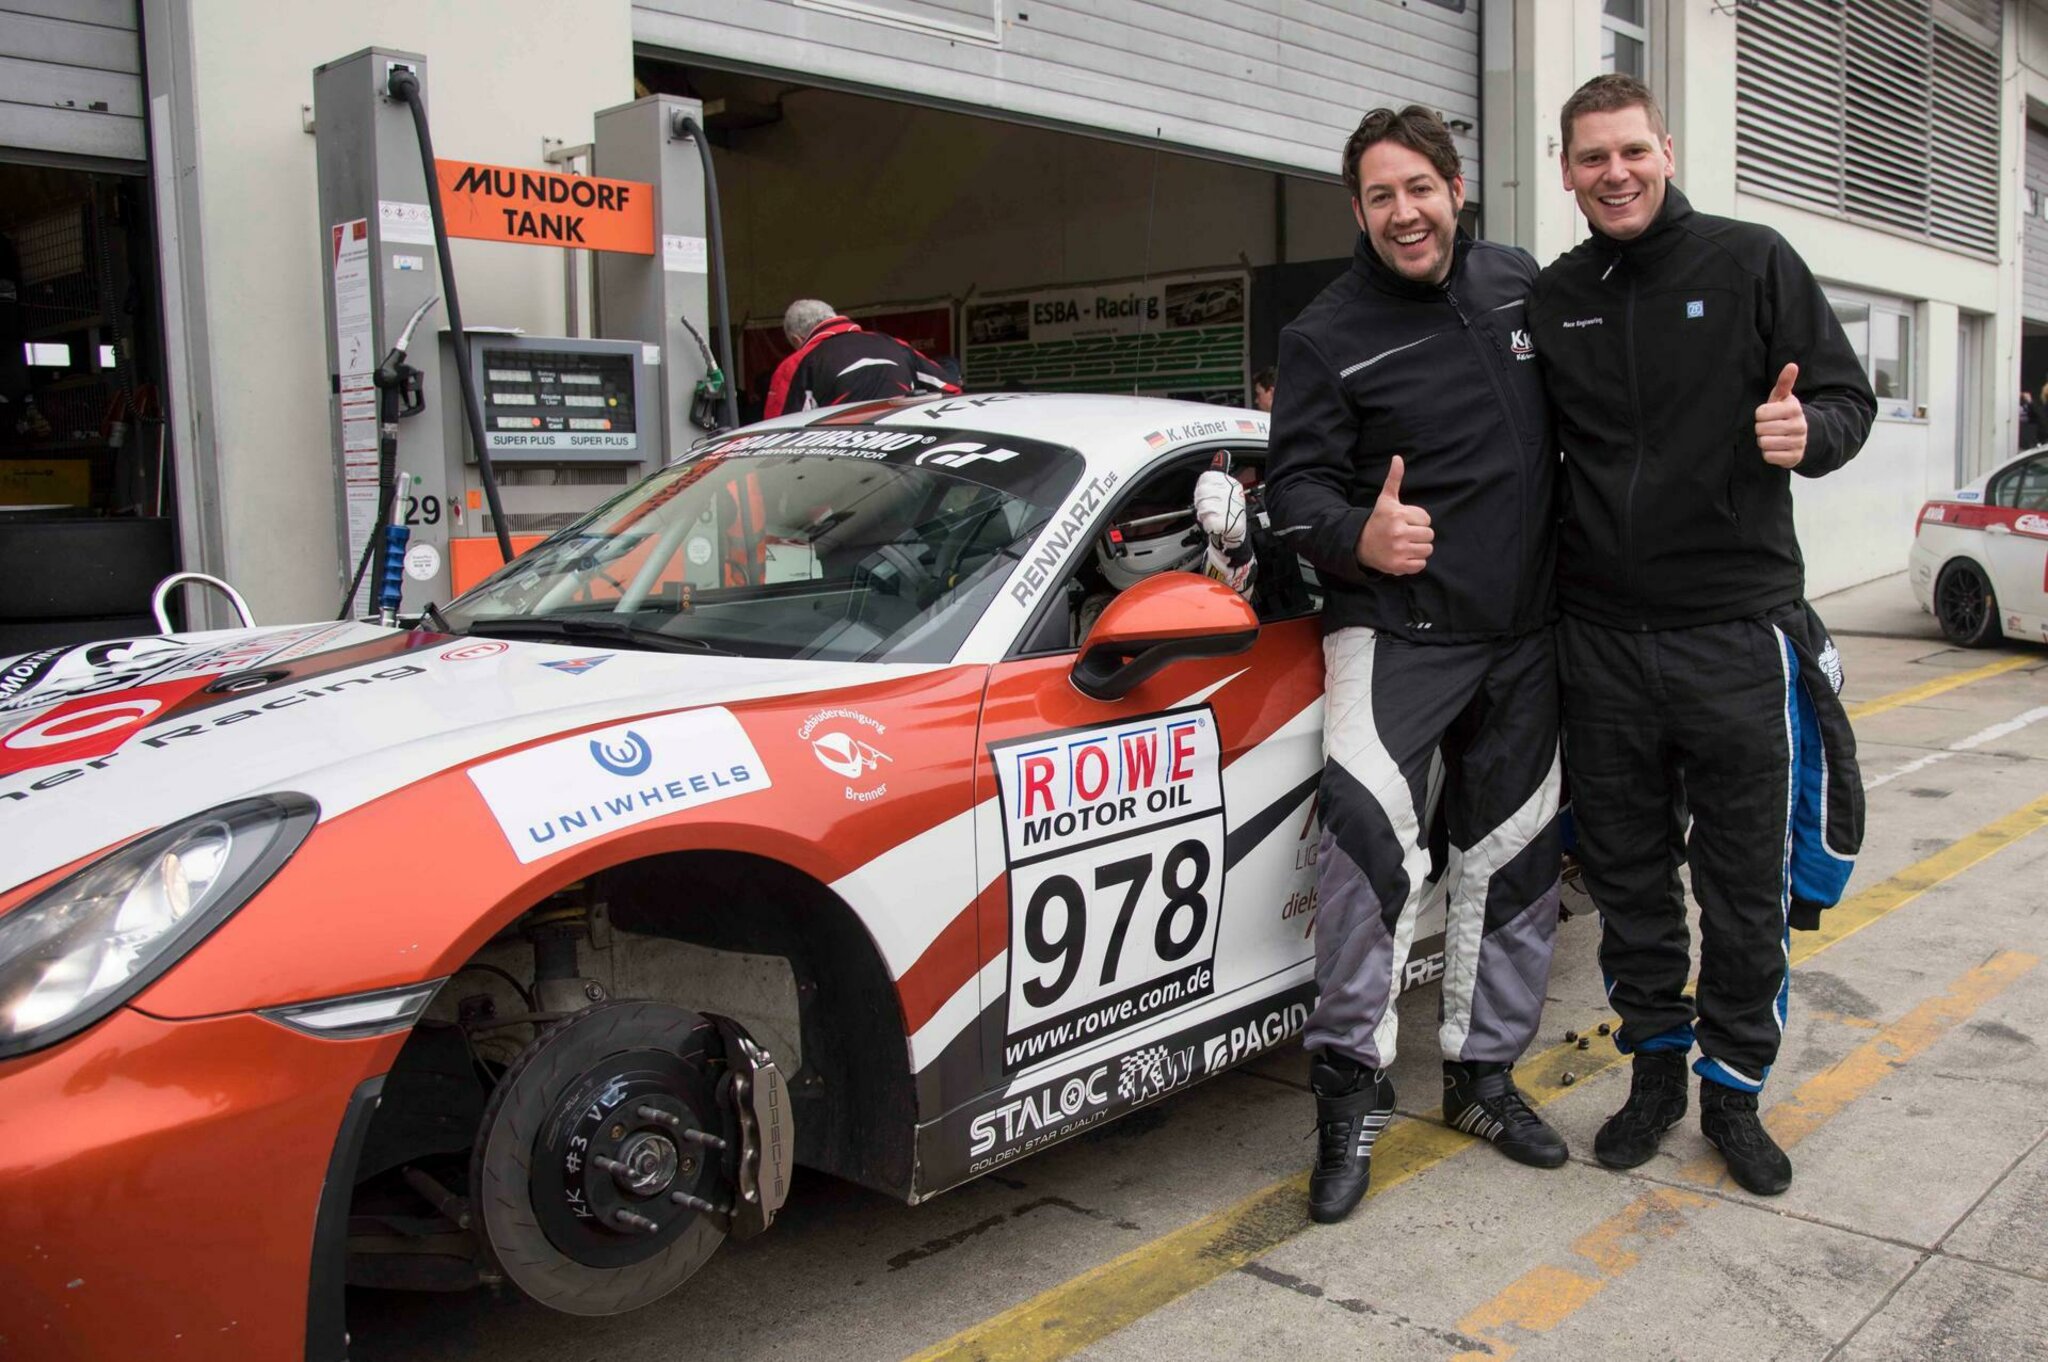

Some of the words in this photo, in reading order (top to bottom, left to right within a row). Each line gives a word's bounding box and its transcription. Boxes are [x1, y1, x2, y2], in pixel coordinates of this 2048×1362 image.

[454, 167, 630, 211] MUNDORF
[503, 209, 586, 243] TANK
[1034, 301, 1079, 325] ESBA
[494, 435, 527, 445] SUPER
[530, 436, 555, 446] PLUS
[570, 436, 601, 446] SUPER
[605, 436, 629, 446] PLUS
[782, 429, 924, 451] TURISMO
[1166, 427, 1182, 442] K.
[1182, 420, 1228, 439] Krämer
[804, 448, 888, 460] SIMULATOR
[404, 495, 441, 526] 29
[140, 665, 428, 749] Racing
[797, 708, 887, 740] Gebäudereinigung
[845, 783, 887, 802] Brenner
[1022, 724, 1197, 819] ROWE
[529, 764, 751, 844] UNIWHEELS
[1023, 796, 1137, 847] MOTOR
[1147, 784, 1192, 813] OIL
[1022, 839, 1211, 1008] 978
[1005, 966, 1212, 1066] www.rowe.com.de
[1230, 1002, 1308, 1063] PAGID
[970, 1066, 1108, 1157] STALOC
[767, 1071, 785, 1198] PORSCHE
[969, 1148, 1022, 1174] GOLDEN
[1025, 1131, 1057, 1152] STAR
[1060, 1108, 1109, 1133] QUALITY
